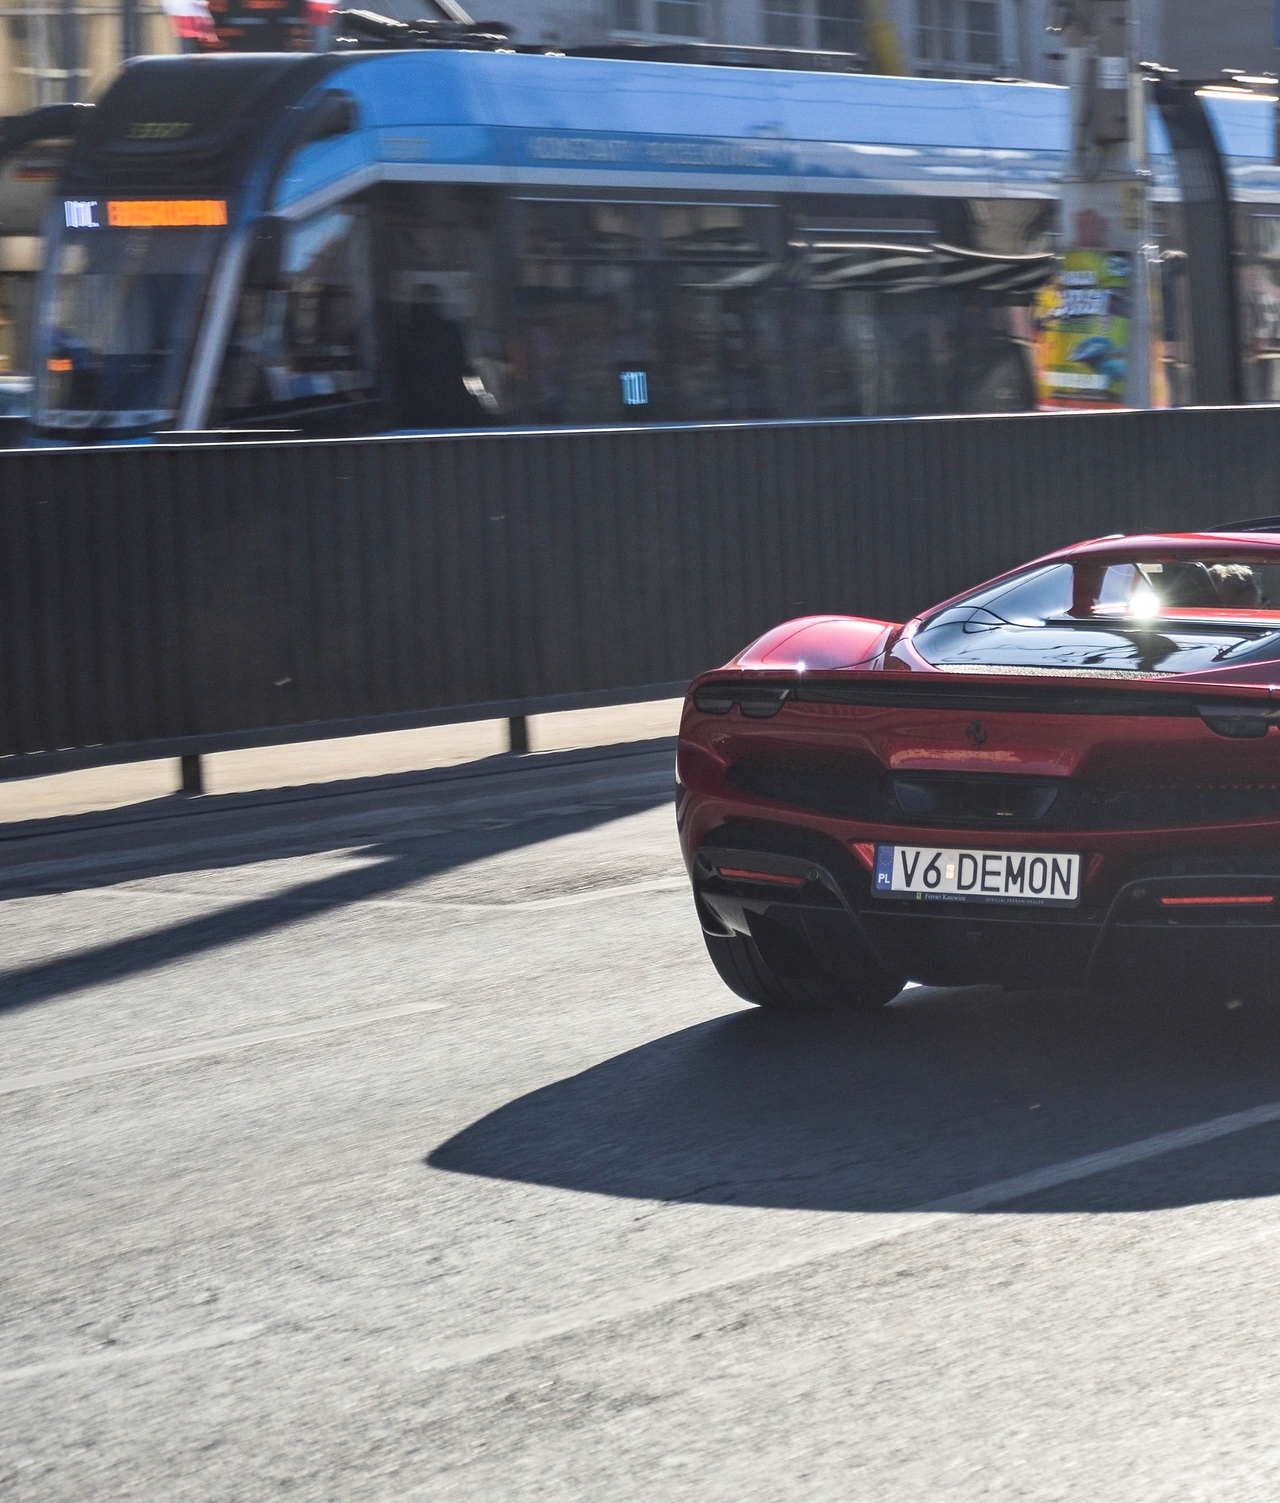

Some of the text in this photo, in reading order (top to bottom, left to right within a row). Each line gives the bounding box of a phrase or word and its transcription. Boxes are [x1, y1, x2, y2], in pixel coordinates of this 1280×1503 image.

[878, 873, 890, 884] PL
[901, 850, 1072, 896] V6 DEMON
[942, 893, 966, 902] Katowice
